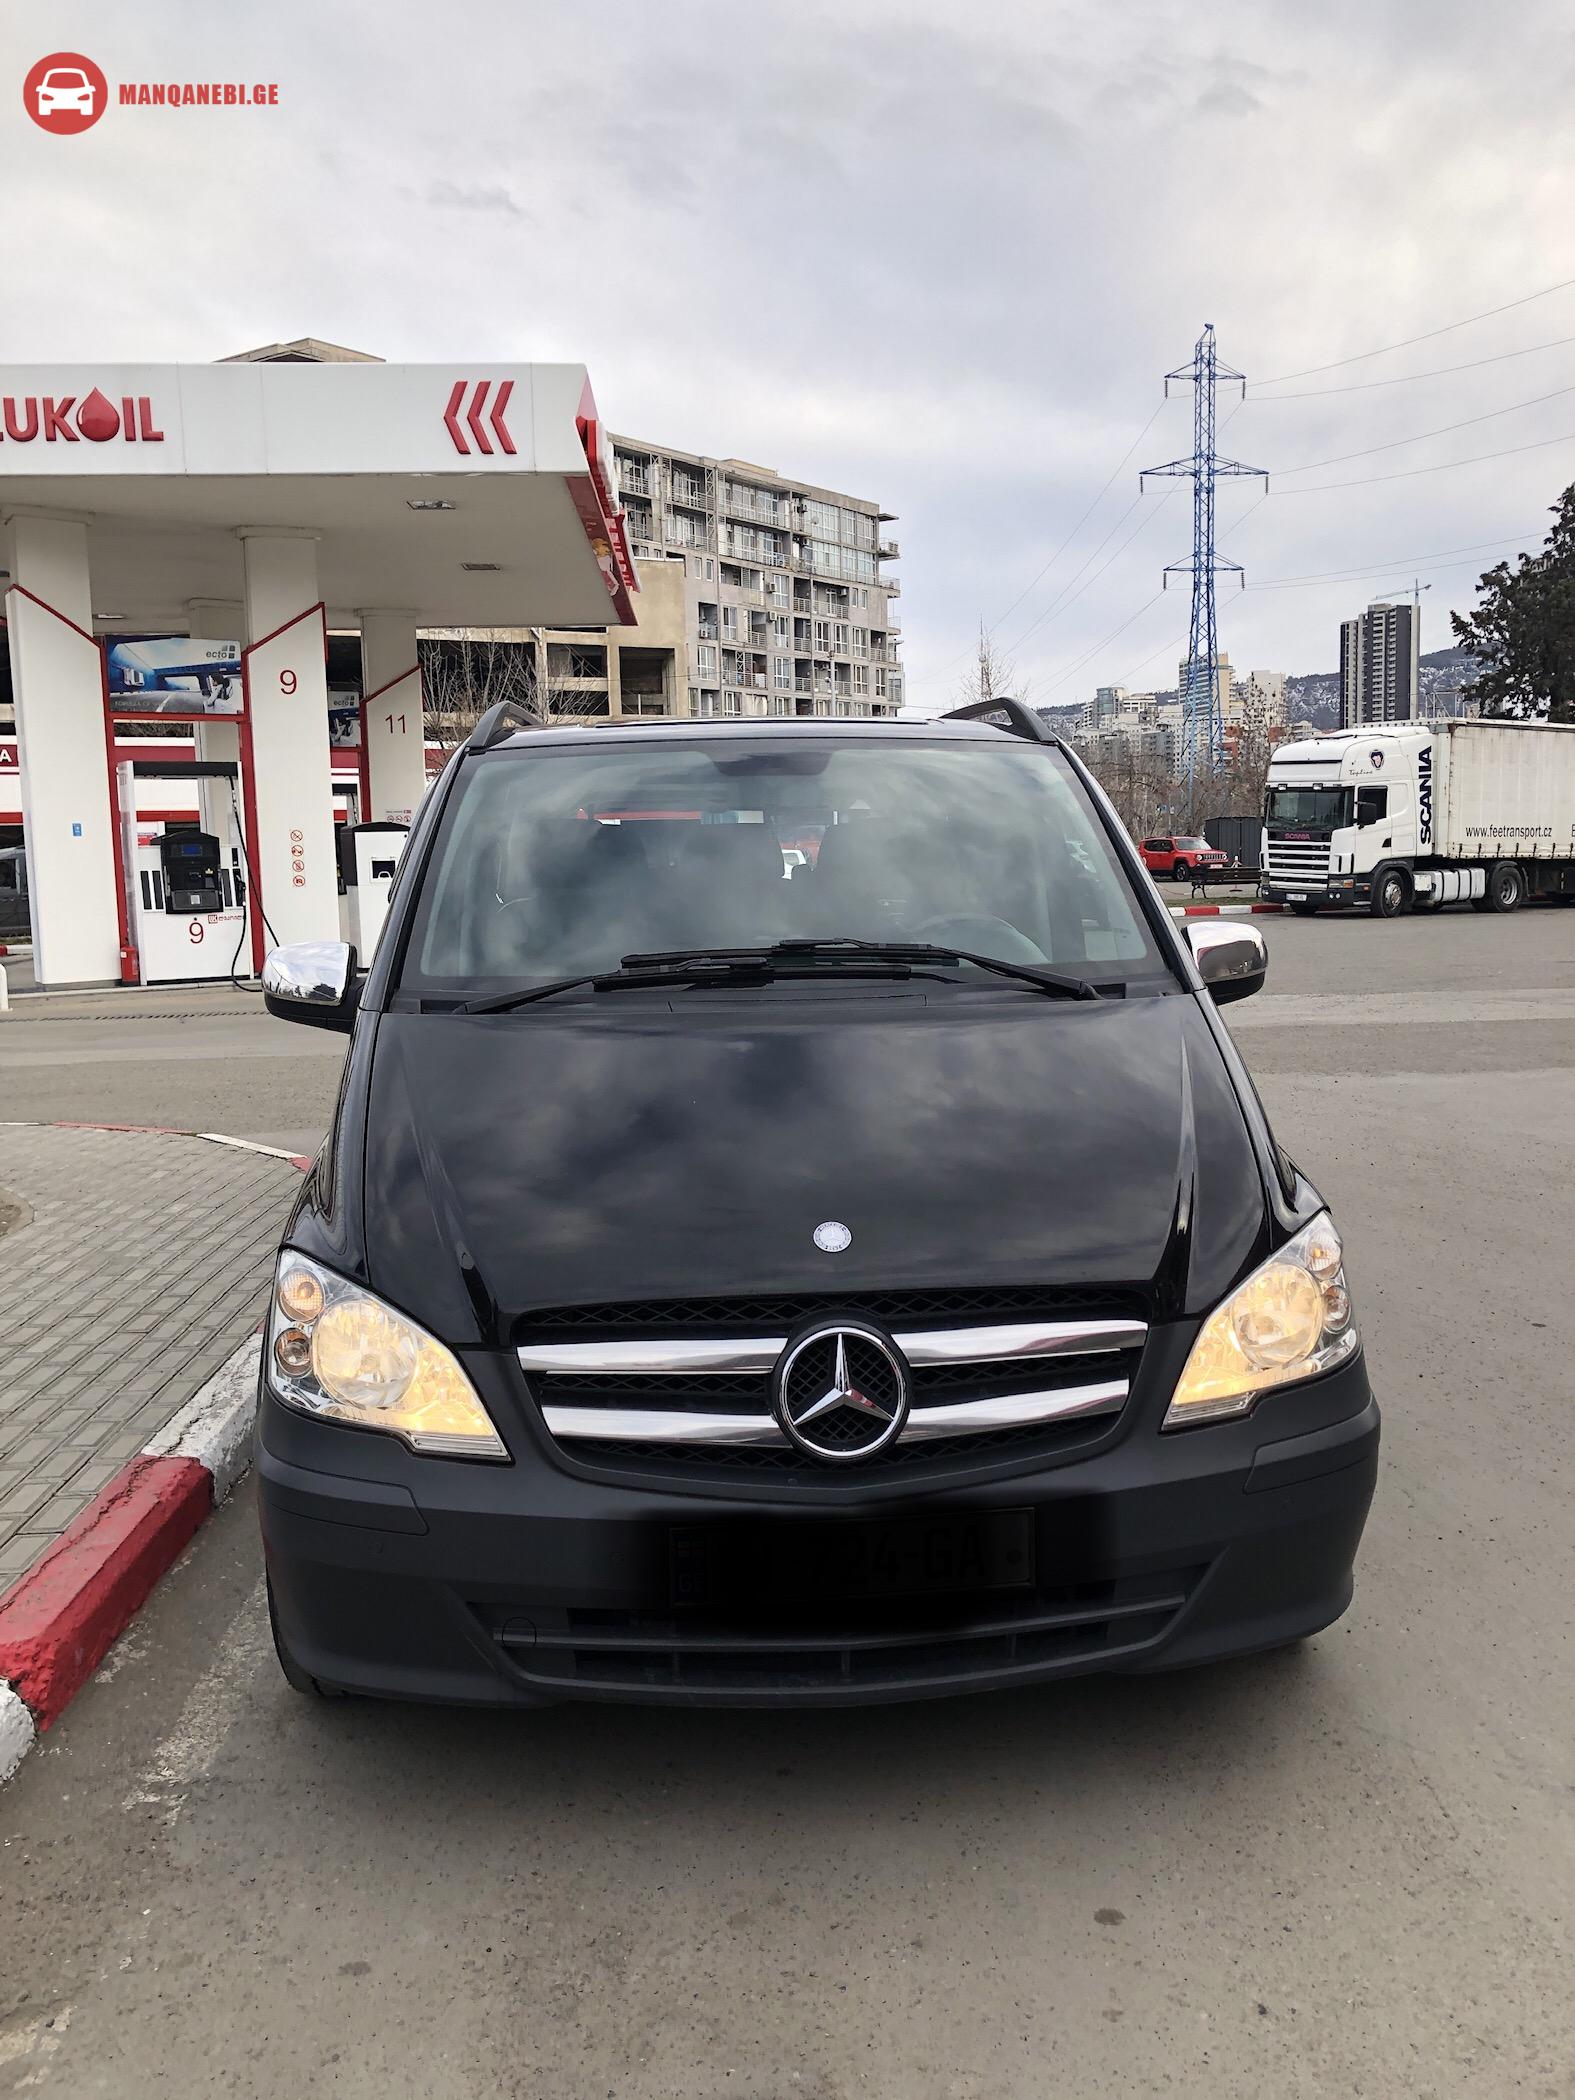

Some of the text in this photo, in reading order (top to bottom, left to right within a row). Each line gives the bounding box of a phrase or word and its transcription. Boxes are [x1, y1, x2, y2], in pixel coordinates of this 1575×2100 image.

[0, 387, 164, 442] UKOIL
[279, 669, 298, 695] 9
[385, 714, 406, 734] 11
[1418, 745, 1432, 845] SCANIA
[1465, 824, 1553, 840] www.feetransport.cz
[189, 921, 205, 945] 9
